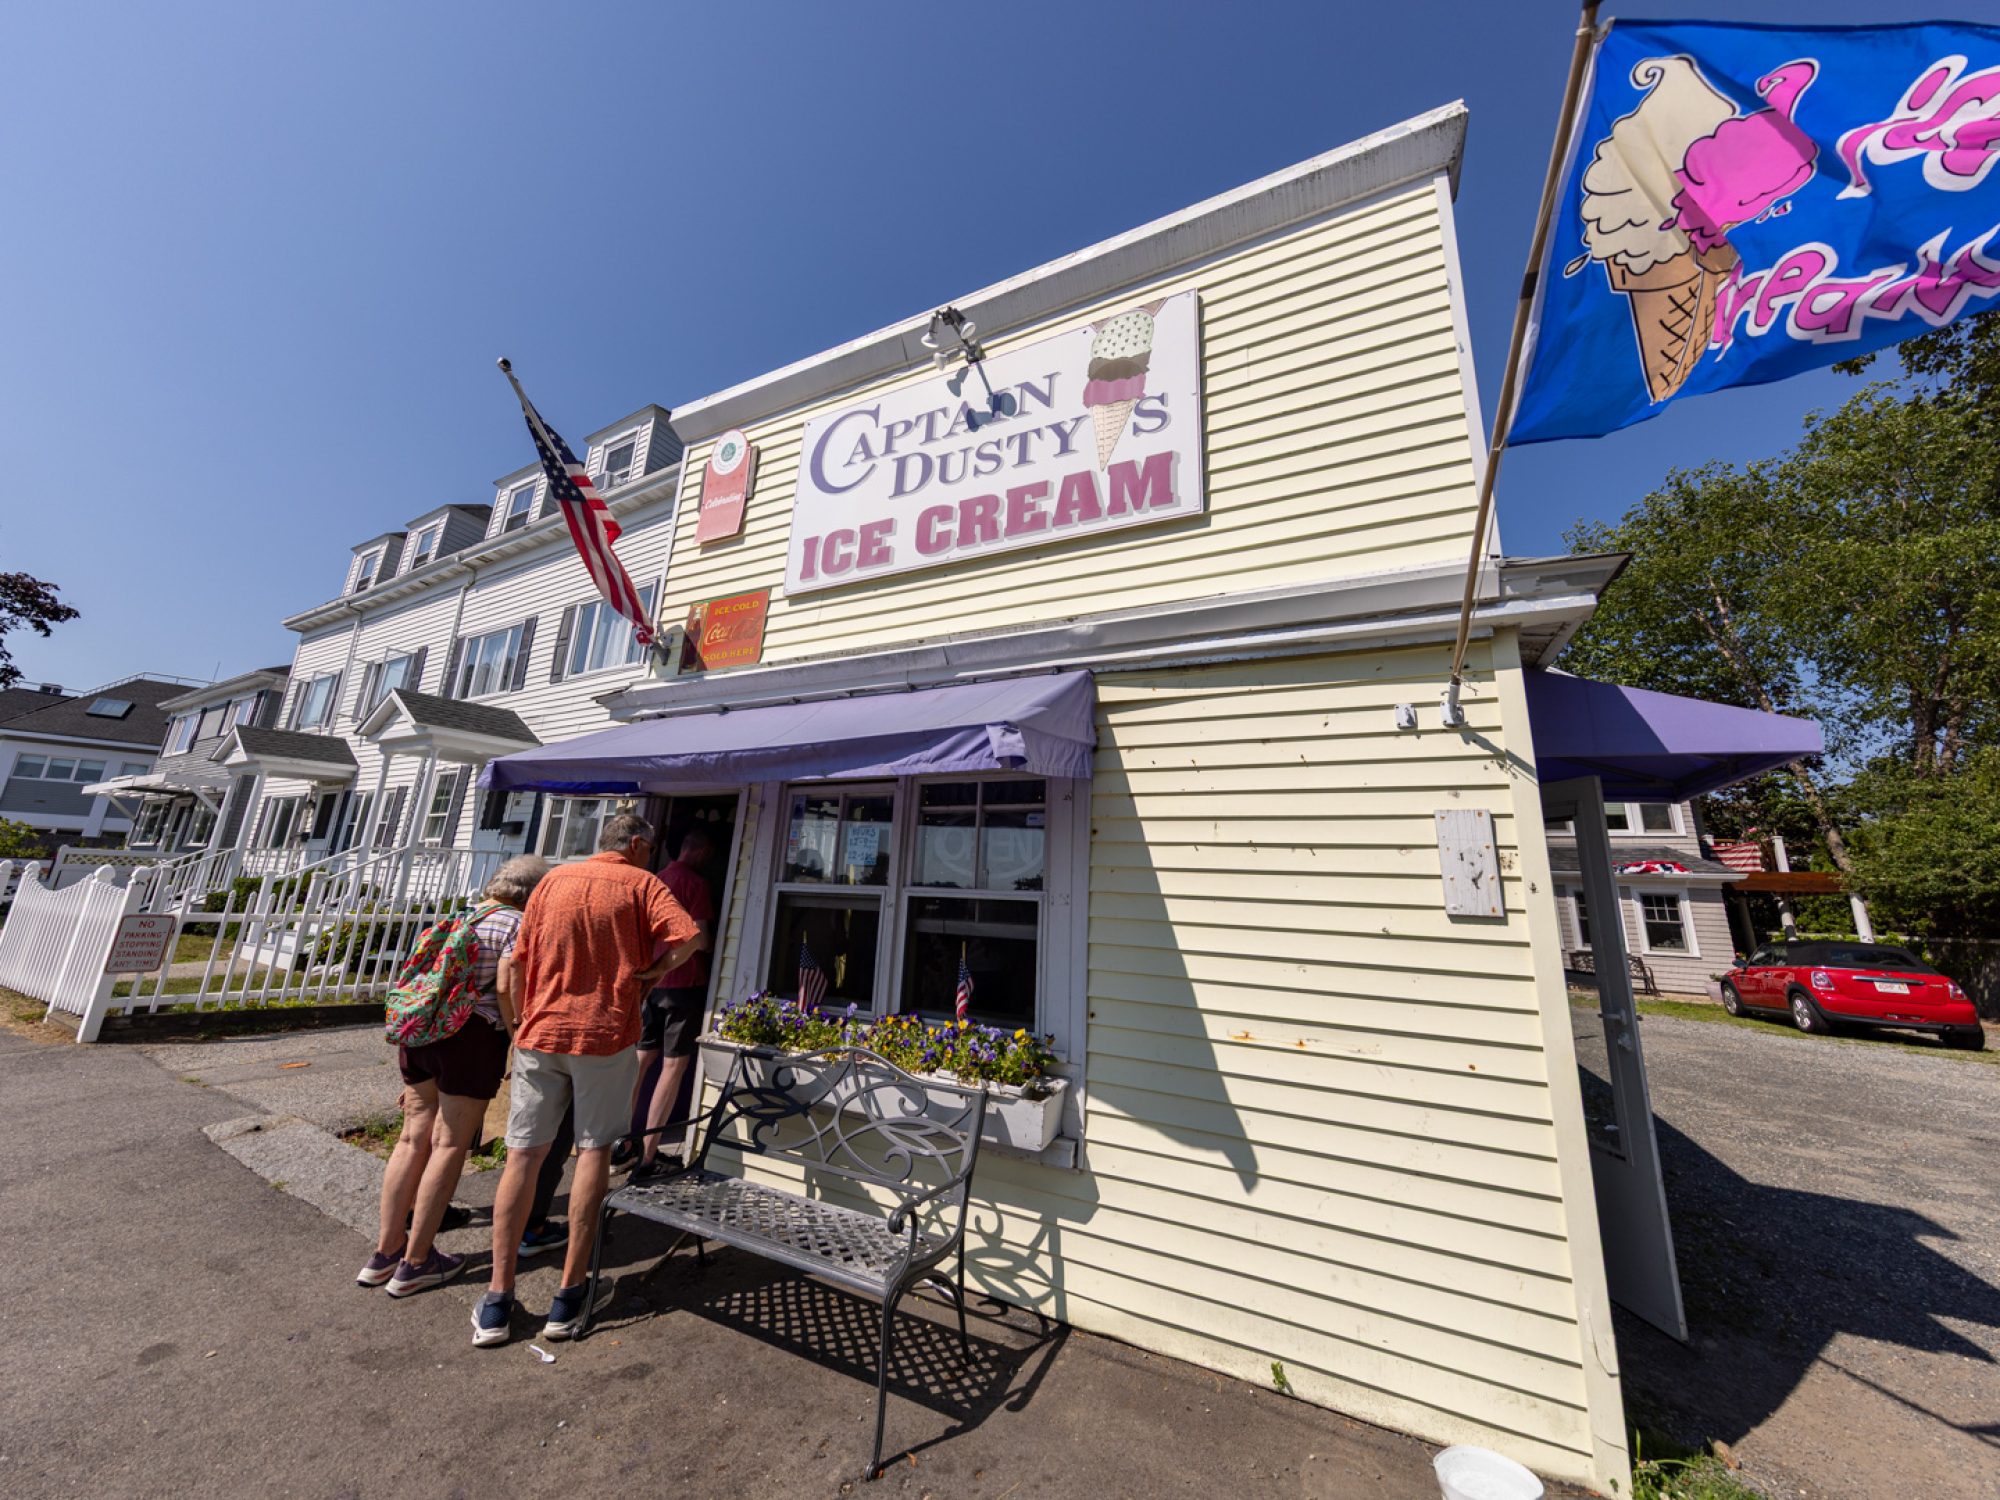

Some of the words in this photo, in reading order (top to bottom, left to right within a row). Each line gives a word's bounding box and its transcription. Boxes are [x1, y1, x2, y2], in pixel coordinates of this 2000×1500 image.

[810, 371, 1061, 494] CAPTAIN
[800, 518, 896, 581] ICE
[914, 451, 1177, 555] CREAM
[714, 606, 730, 616] ICE
[732, 601, 759, 612] COLD
[703, 650, 727, 662] SOLD
[138, 920, 155, 928] NO
[125, 931, 162, 939] PARKING
[119, 941, 161, 949] STOPPING
[114, 950, 159, 958] STANDING
[112, 960, 130, 968] ANY
[135, 960, 155, 968] TIME
